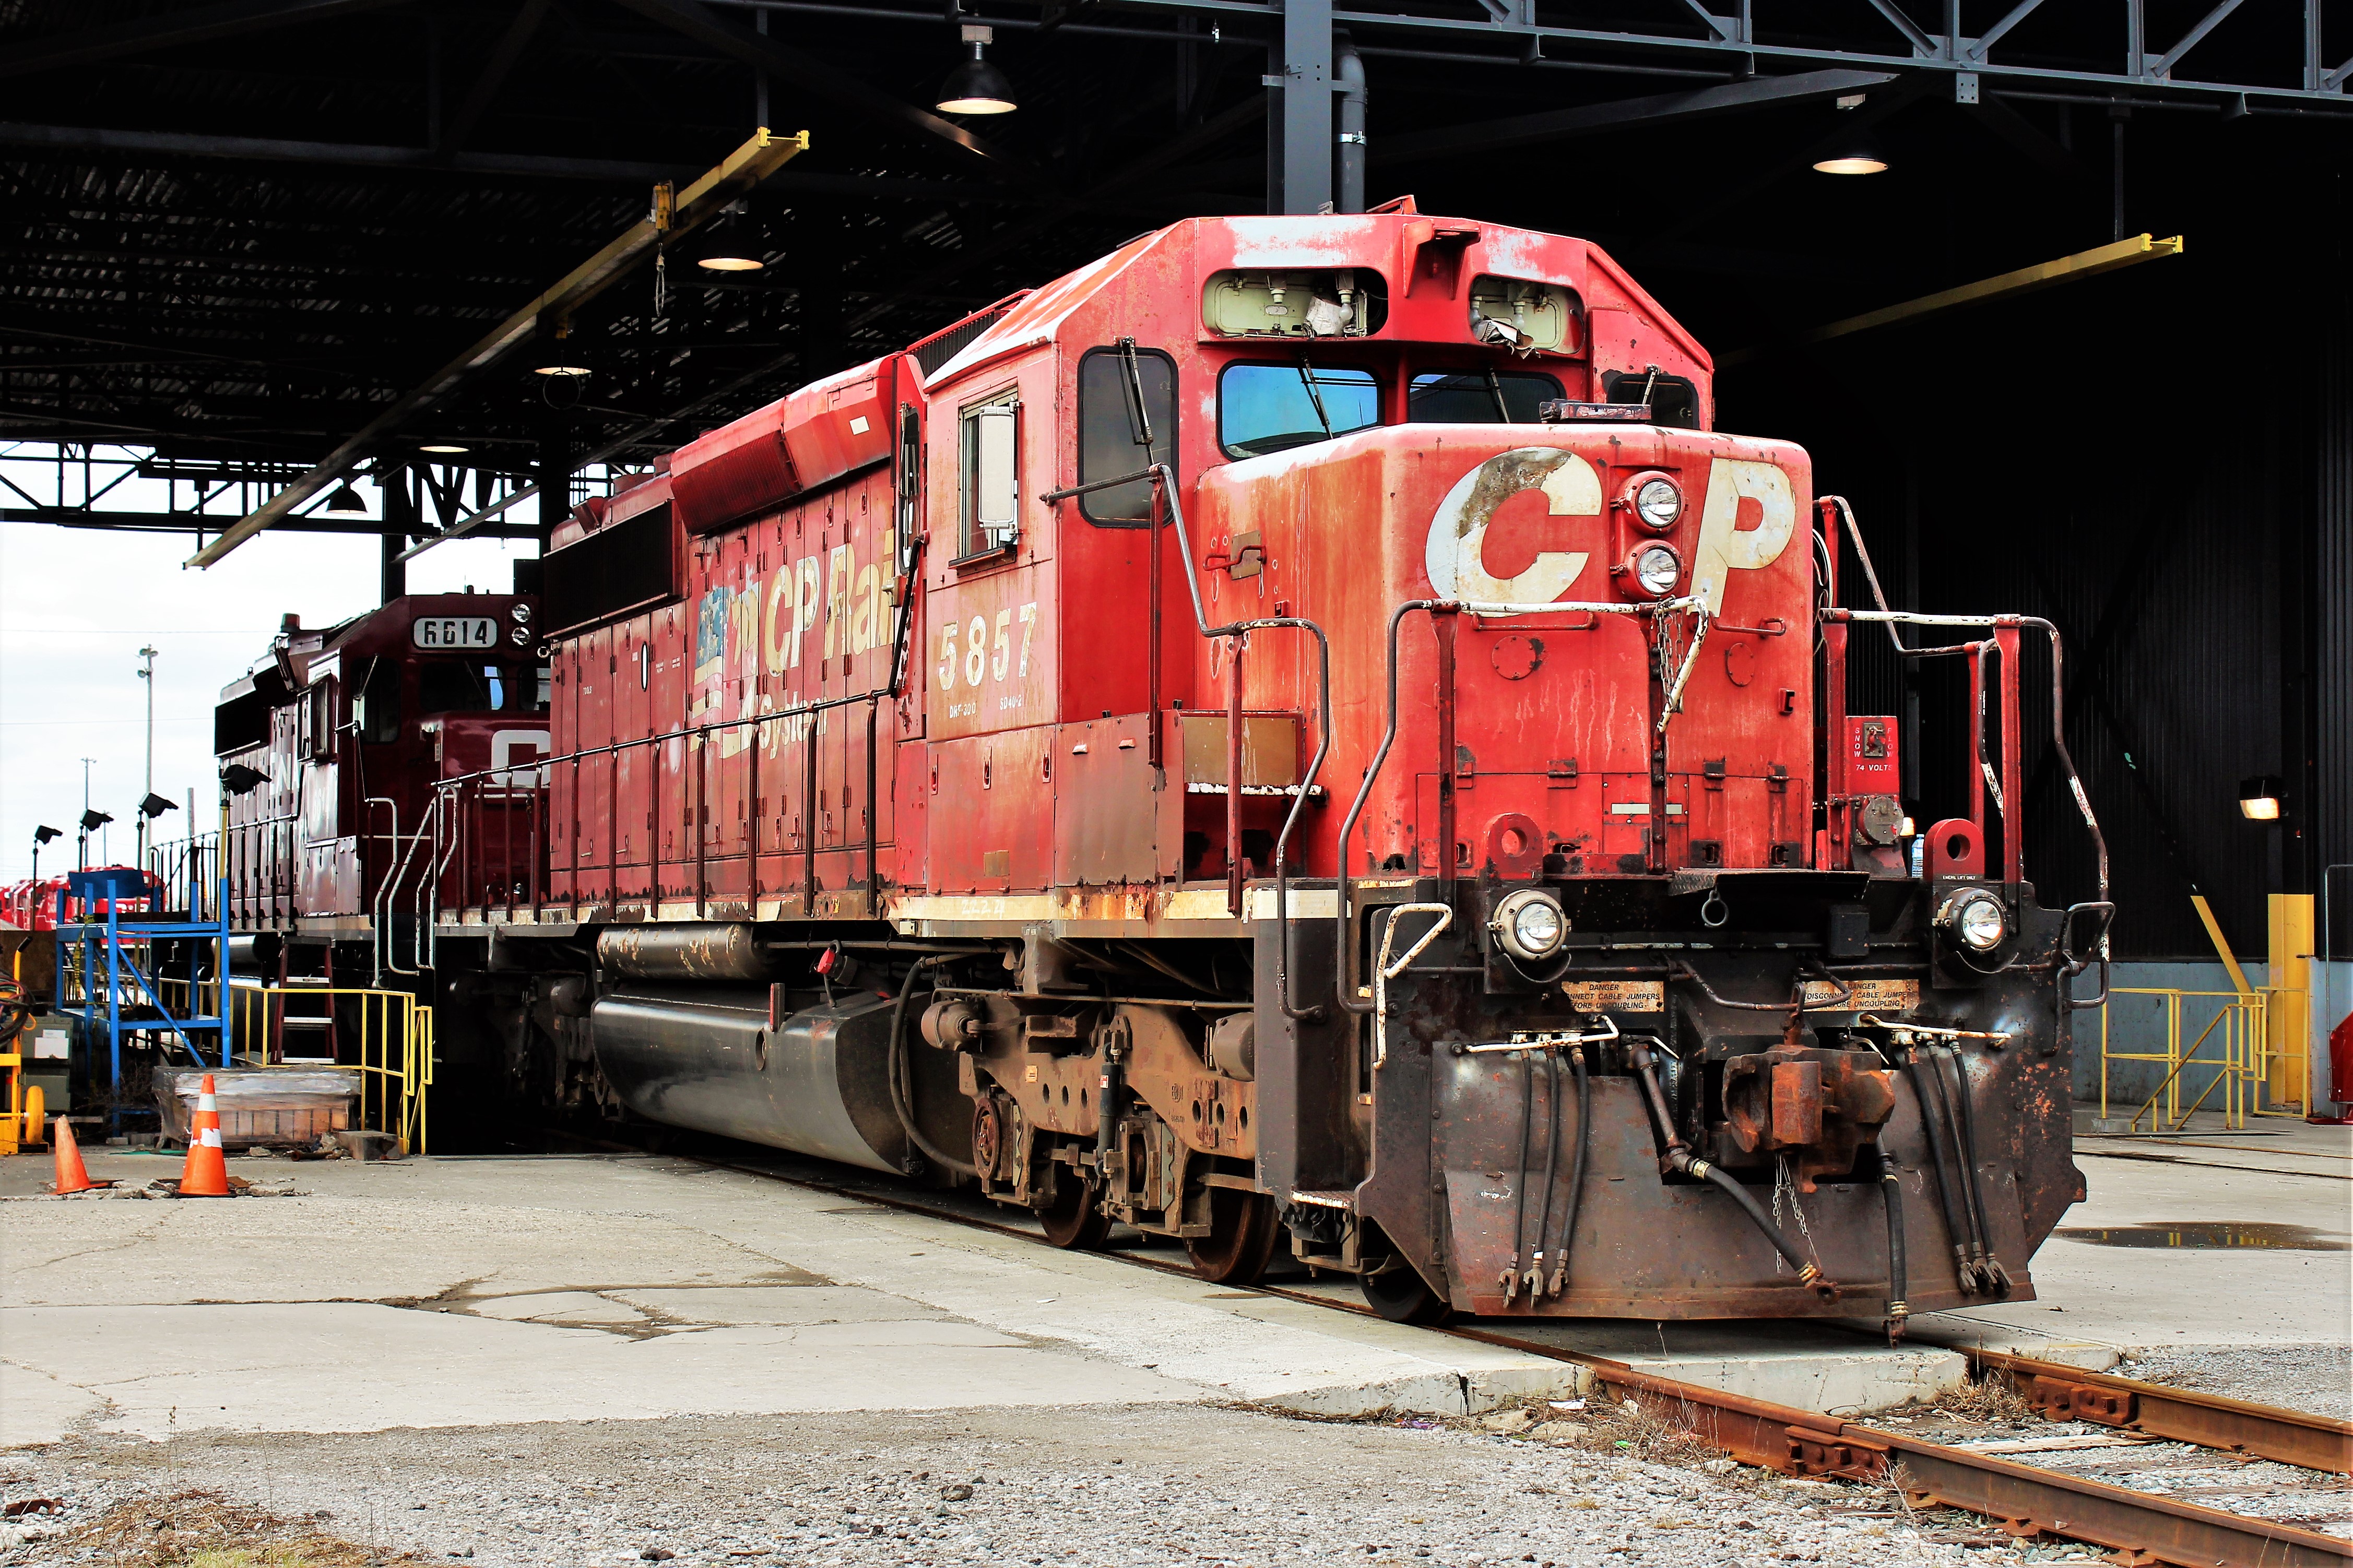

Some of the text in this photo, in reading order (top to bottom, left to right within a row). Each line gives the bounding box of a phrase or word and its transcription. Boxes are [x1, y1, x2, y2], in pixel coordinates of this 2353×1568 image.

[1425, 446, 1796, 617] CP
[423, 621, 487, 644] 6614
[764, 555, 820, 678] CP
[939, 602, 1037, 691] 5857
[1000, 694, 1022, 710] SD40-2
